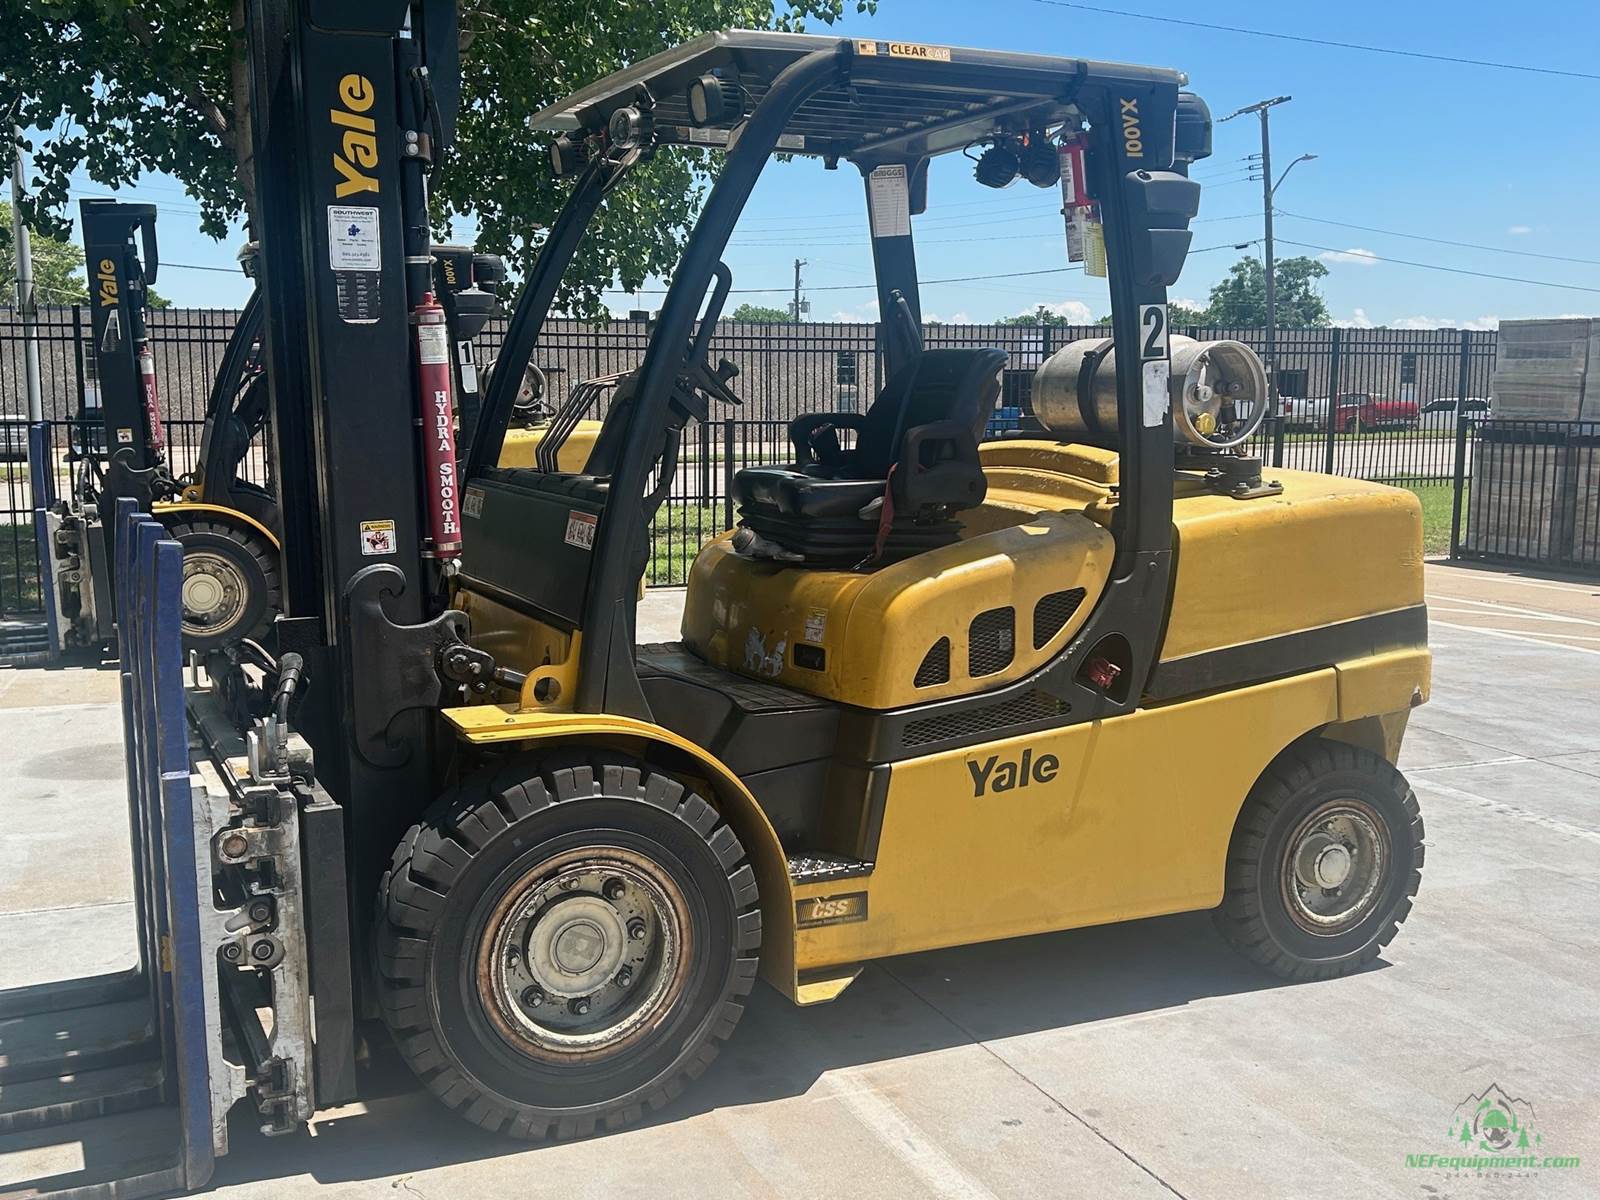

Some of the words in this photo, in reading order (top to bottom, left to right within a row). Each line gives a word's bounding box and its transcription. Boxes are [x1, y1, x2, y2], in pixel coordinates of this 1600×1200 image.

[330, 73, 379, 198] Yale
[1120, 97, 1144, 157] 100VX
[97, 259, 119, 307] Yale
[443, 259, 457, 284] 100VX
[461, 342, 471, 363] 1
[1143, 306, 1164, 357] 2
[434, 390, 451, 451] HYDRA
[439, 463, 458, 534] SMOOTH
[967, 748, 1060, 798] Yale
[811, 900, 849, 919] CSS
